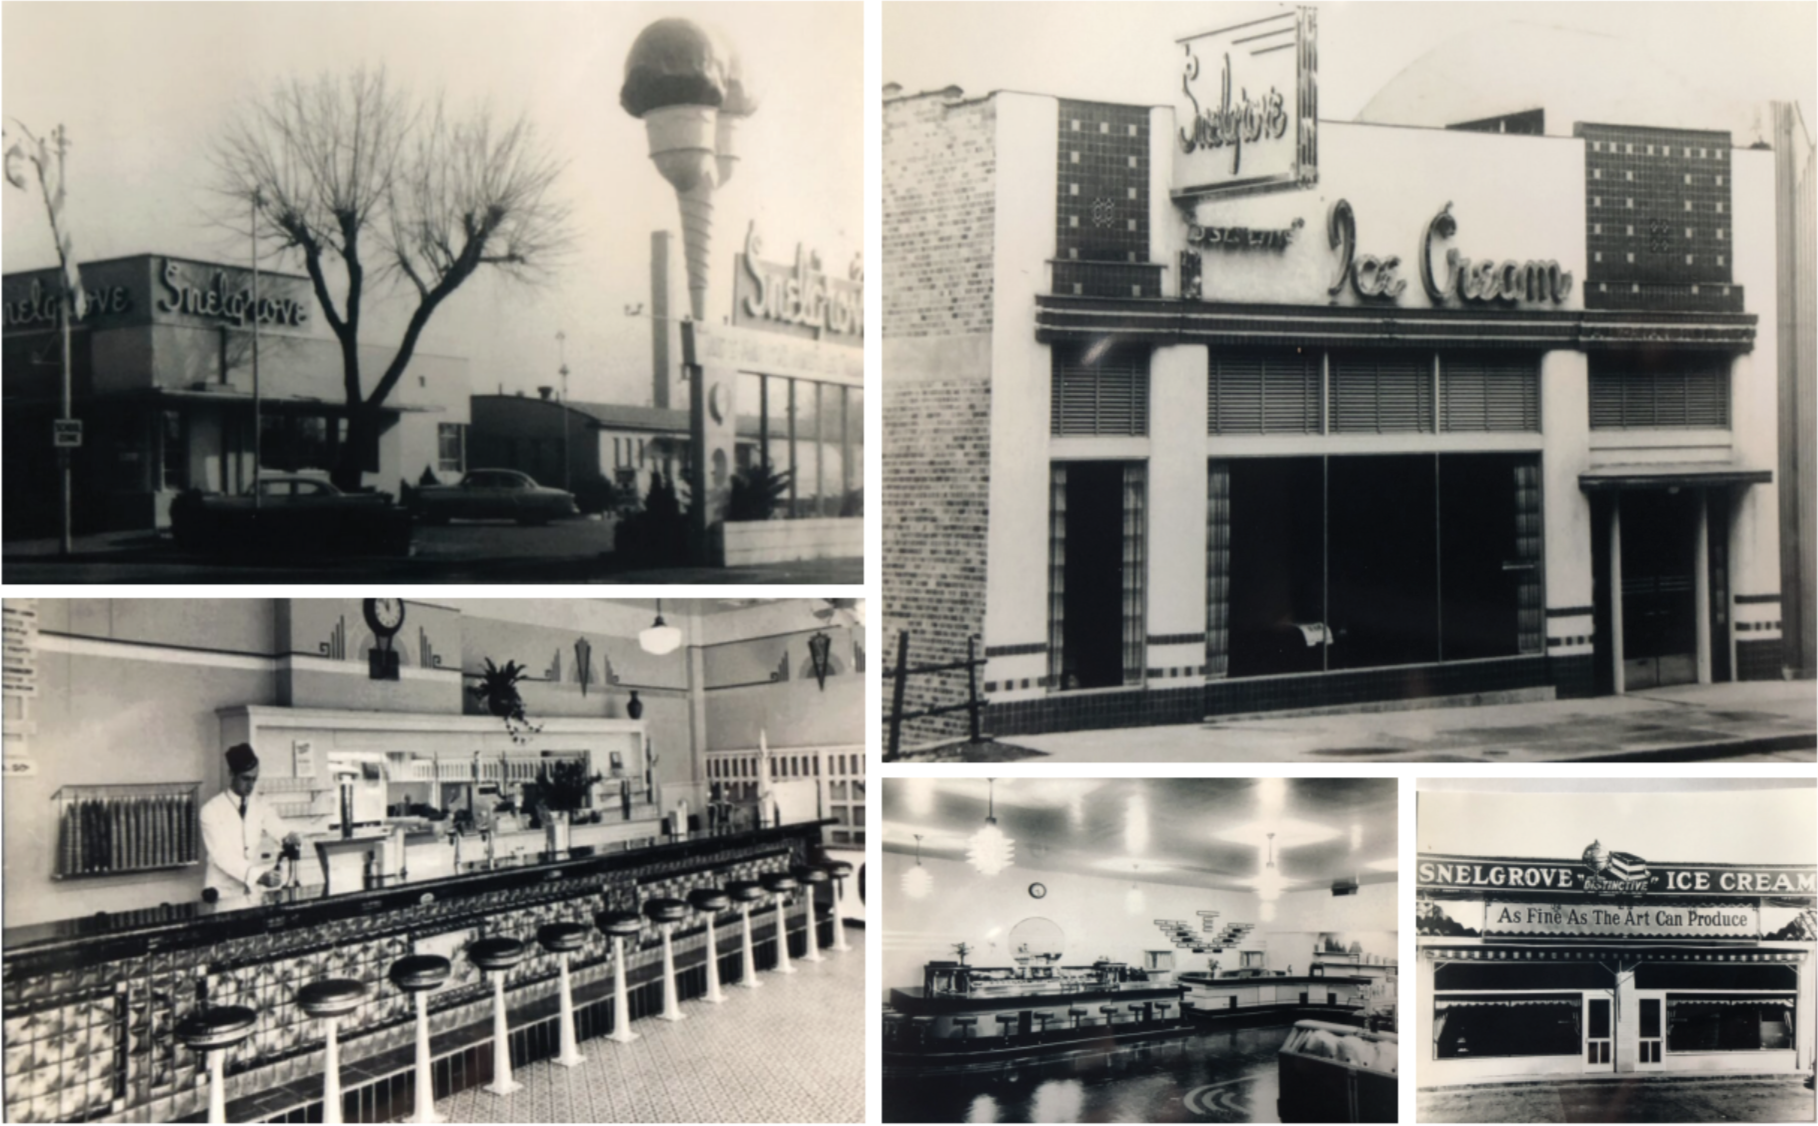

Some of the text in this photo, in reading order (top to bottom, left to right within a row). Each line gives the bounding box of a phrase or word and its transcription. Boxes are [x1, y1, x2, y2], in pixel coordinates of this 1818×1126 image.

[1181, 44, 1287, 175] Snelgrove
[1327, 198, 1573, 307] Ice Cream
[157, 257, 309, 328] Snelgrove
[1419, 862, 1573, 888] SNELGROVE
[1666, 871, 1710, 891] ICE
[1720, 873, 1817, 893] CREAM
[1497, 907, 1748, 928] As Fine As The Art Can Produce
